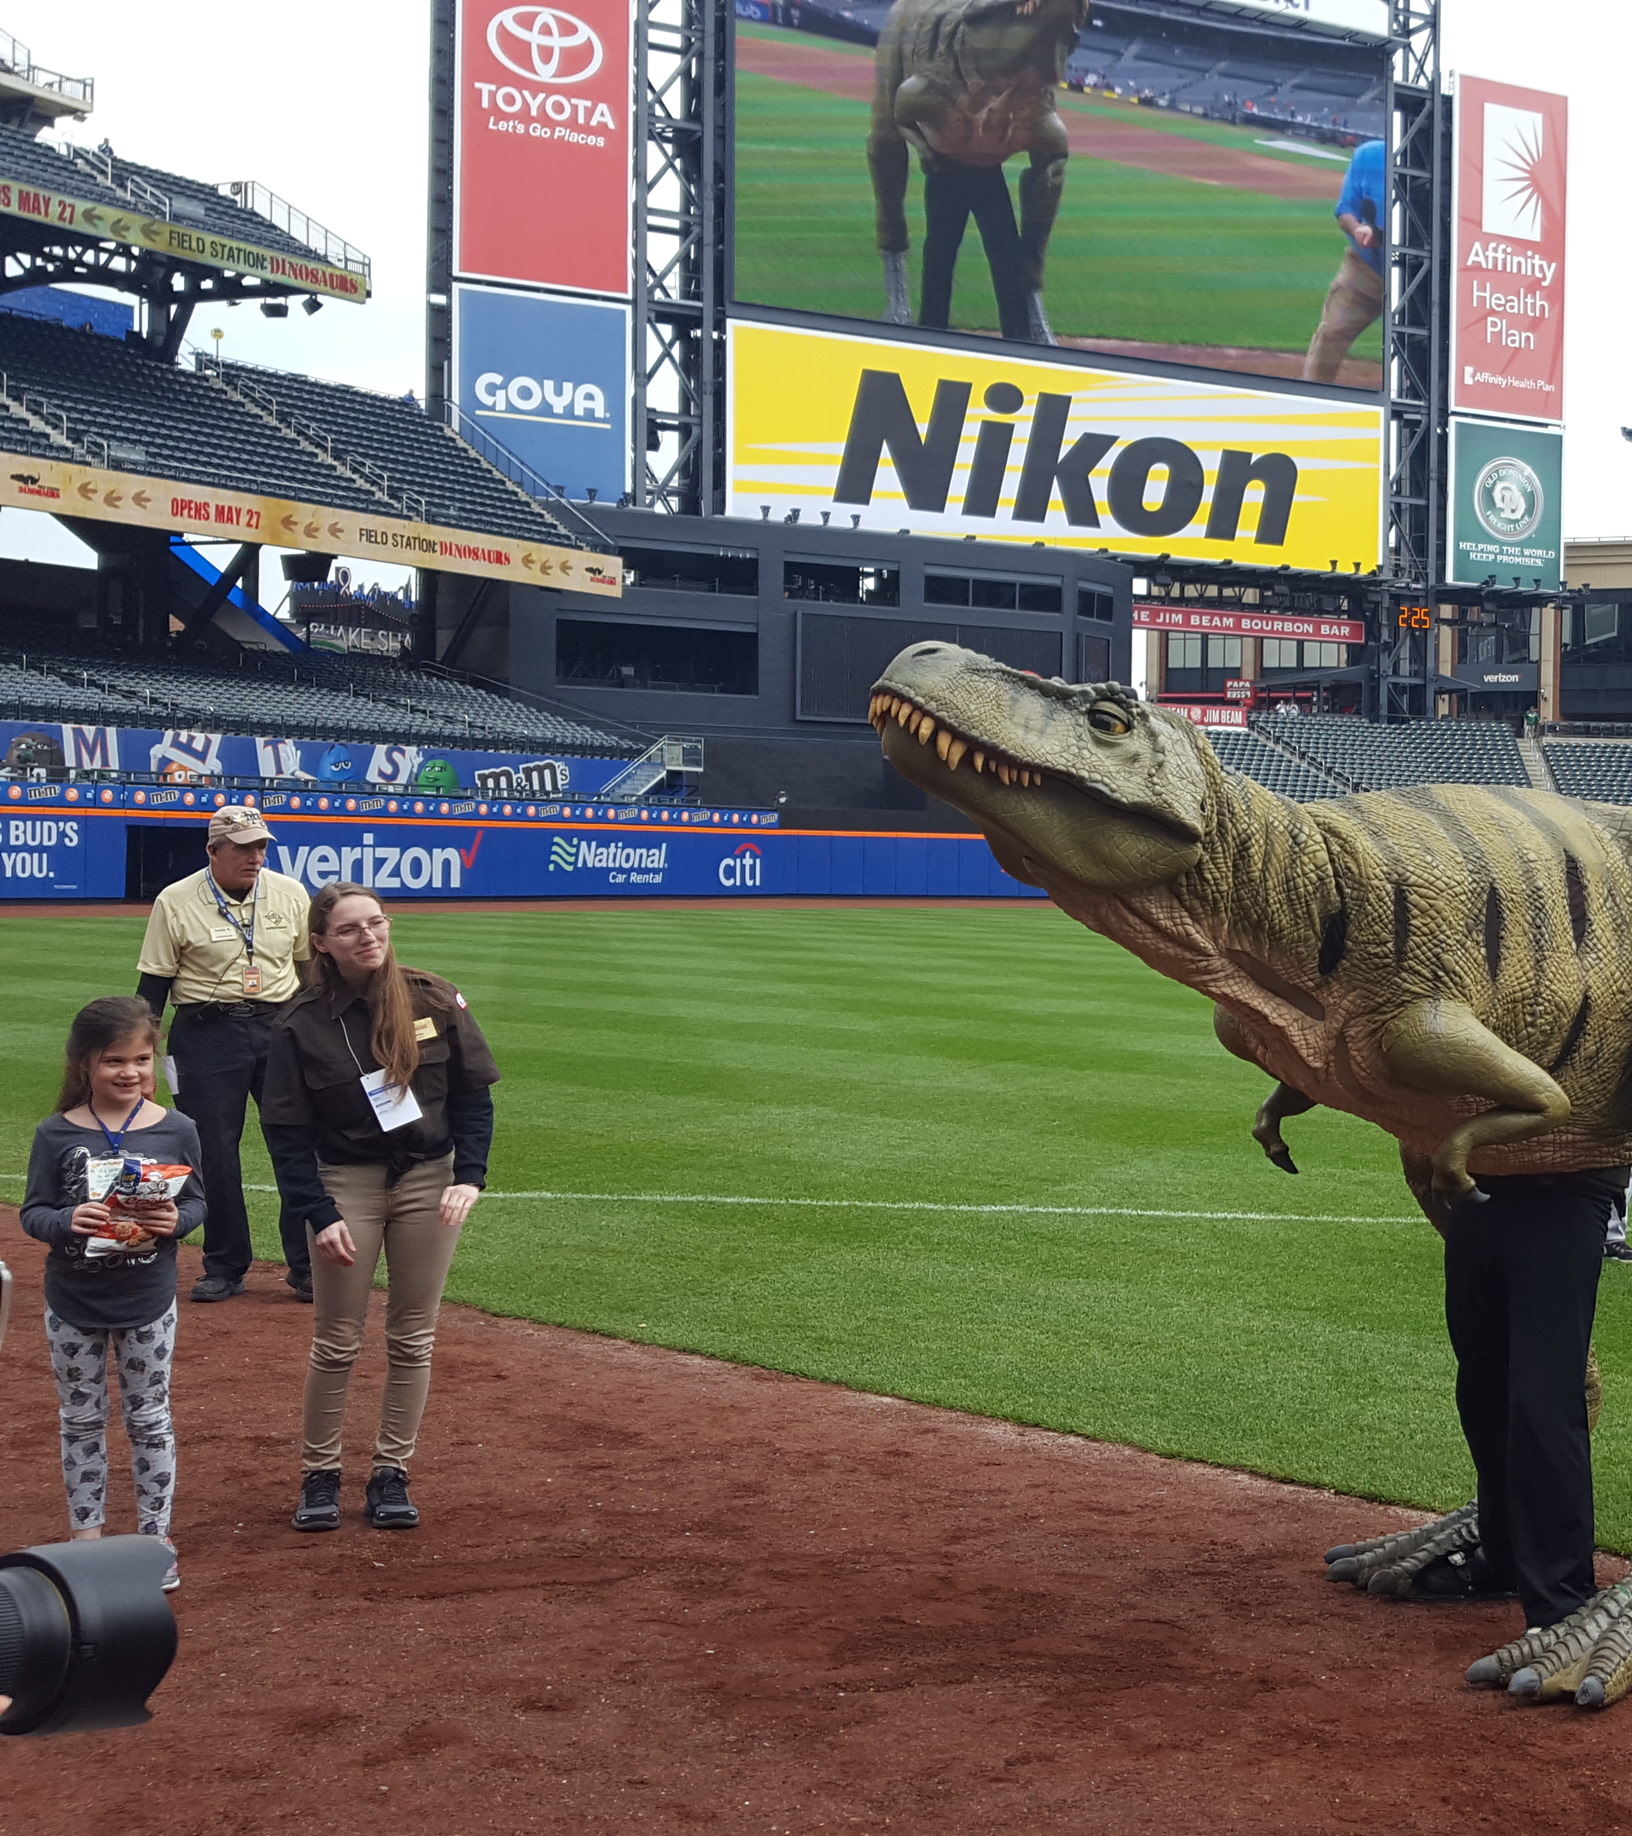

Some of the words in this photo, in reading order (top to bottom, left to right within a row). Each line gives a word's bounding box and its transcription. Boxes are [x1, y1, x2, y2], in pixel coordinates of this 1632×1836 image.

[474, 82, 616, 130] TOYOTA
[488, 116, 525, 134] Let's
[528, 123, 551, 138] Go
[553, 127, 606, 147] Places
[18, 189, 52, 219] MAY
[57, 199, 76, 225] 27
[168, 228, 206, 255] FIELD
[269, 256, 360, 295] DINOSAURS
[1466, 241, 1557, 287] Affinity
[1472, 280, 1550, 319] Health
[1485, 315, 1535, 351] Plan
[475, 371, 606, 419] GOYA
[1474, 371, 1508, 388] Affinity
[1507, 376, 1536, 390] Health
[1537, 379, 1555, 392] Plan
[832, 367, 1298, 548] Nikon
[1484, 471, 1499, 488] OLD
[1499, 468, 1533, 493] DOMINION
[170, 497, 210, 522] OPENS
[214, 507, 244, 526] MAY
[246, 508, 261, 530] 27
[1485, 510, 1516, 532] FREIGHT
[1515, 514, 1531, 531] LINE
[358, 527, 388, 546] FIELD
[439, 541, 512, 567] DINOSAURS
[1459, 541, 1500, 554] HELPING
[1502, 546, 1521, 556] THE
[1523, 548, 1556, 560] WORLD
[1469, 552, 1495, 562] KEEP
[1156, 612, 1183, 625] JIM
[1190, 614, 1234, 629] BEAM
[1241, 619, 1314, 635] BOURBON
[1320, 624, 1350, 637] BAR
[1398, 606, 1431, 629] 2:25
[1483, 673, 1519, 683] verizon
[1203, 708, 1220, 723] JIM
[1221, 710, 1242, 724] BEAM
[1, 852, 55, 878] YOU.
[276, 832, 461, 889] verizon
[577, 841, 667, 869] National
[718, 850, 761, 887] citi
[608, 871, 627, 883] Car
[629, 871, 663, 884] Rental
